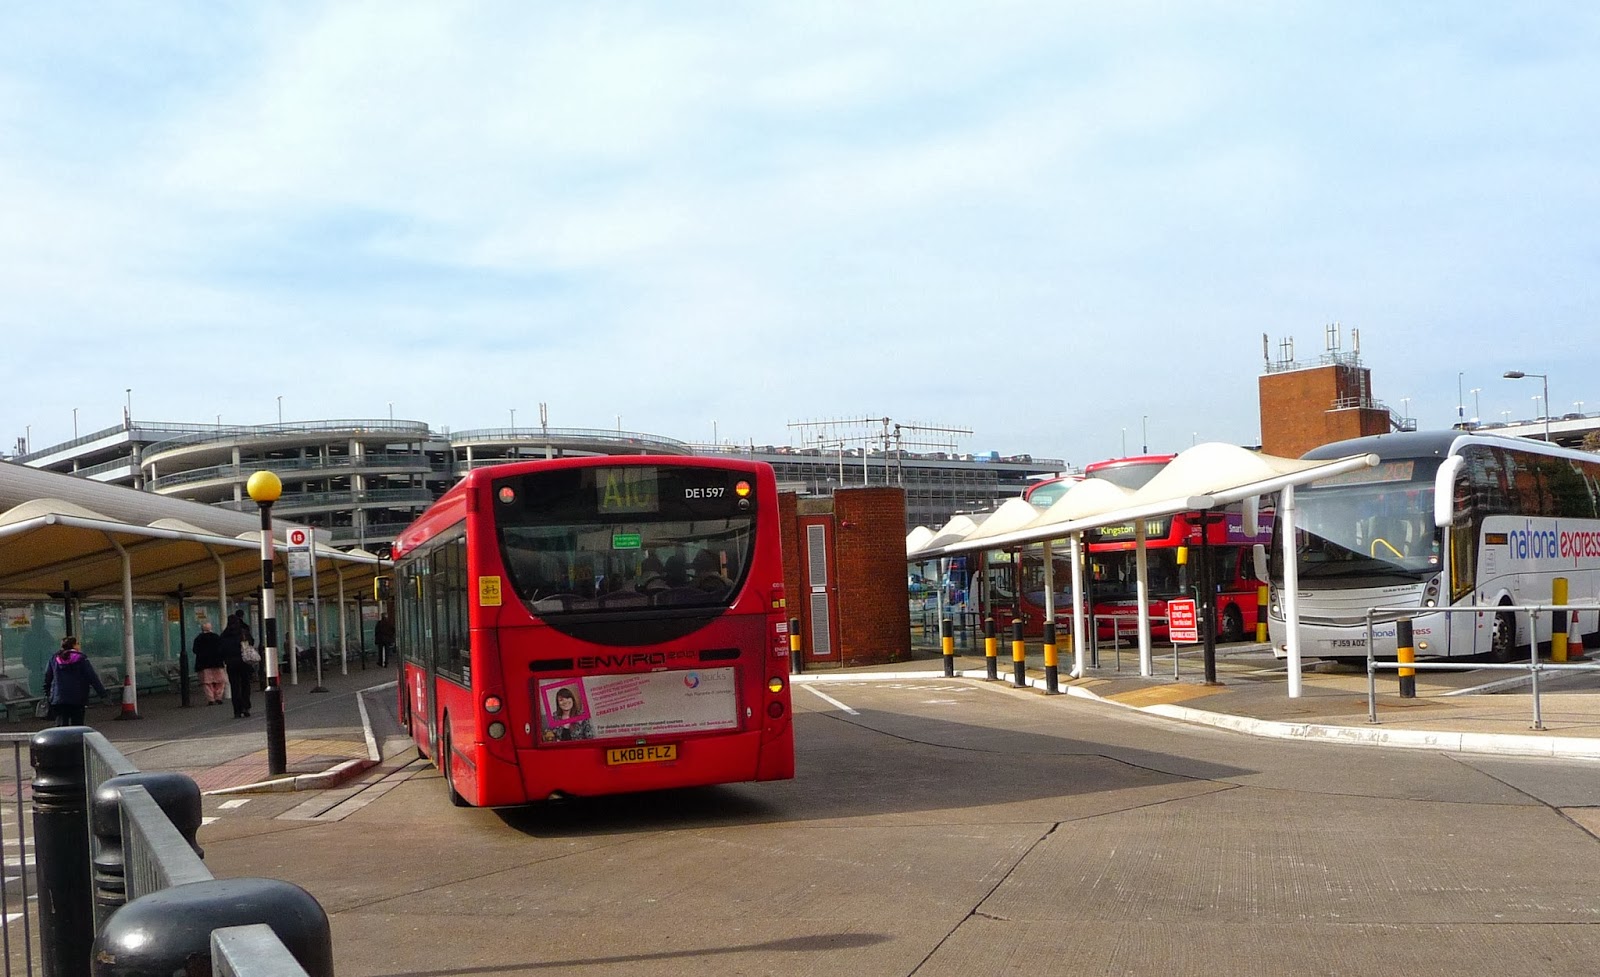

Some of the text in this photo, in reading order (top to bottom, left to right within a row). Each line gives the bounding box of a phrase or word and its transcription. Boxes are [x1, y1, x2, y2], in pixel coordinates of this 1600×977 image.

[684, 488, 724, 498] DE1597
[293, 534, 302, 542] 18
[1100, 526, 1134, 537] Kingston
[1510, 519, 1600, 568] national express
[578, 652, 666, 669] ENVIRO
[612, 746, 671, 762] LK08 FLZ
